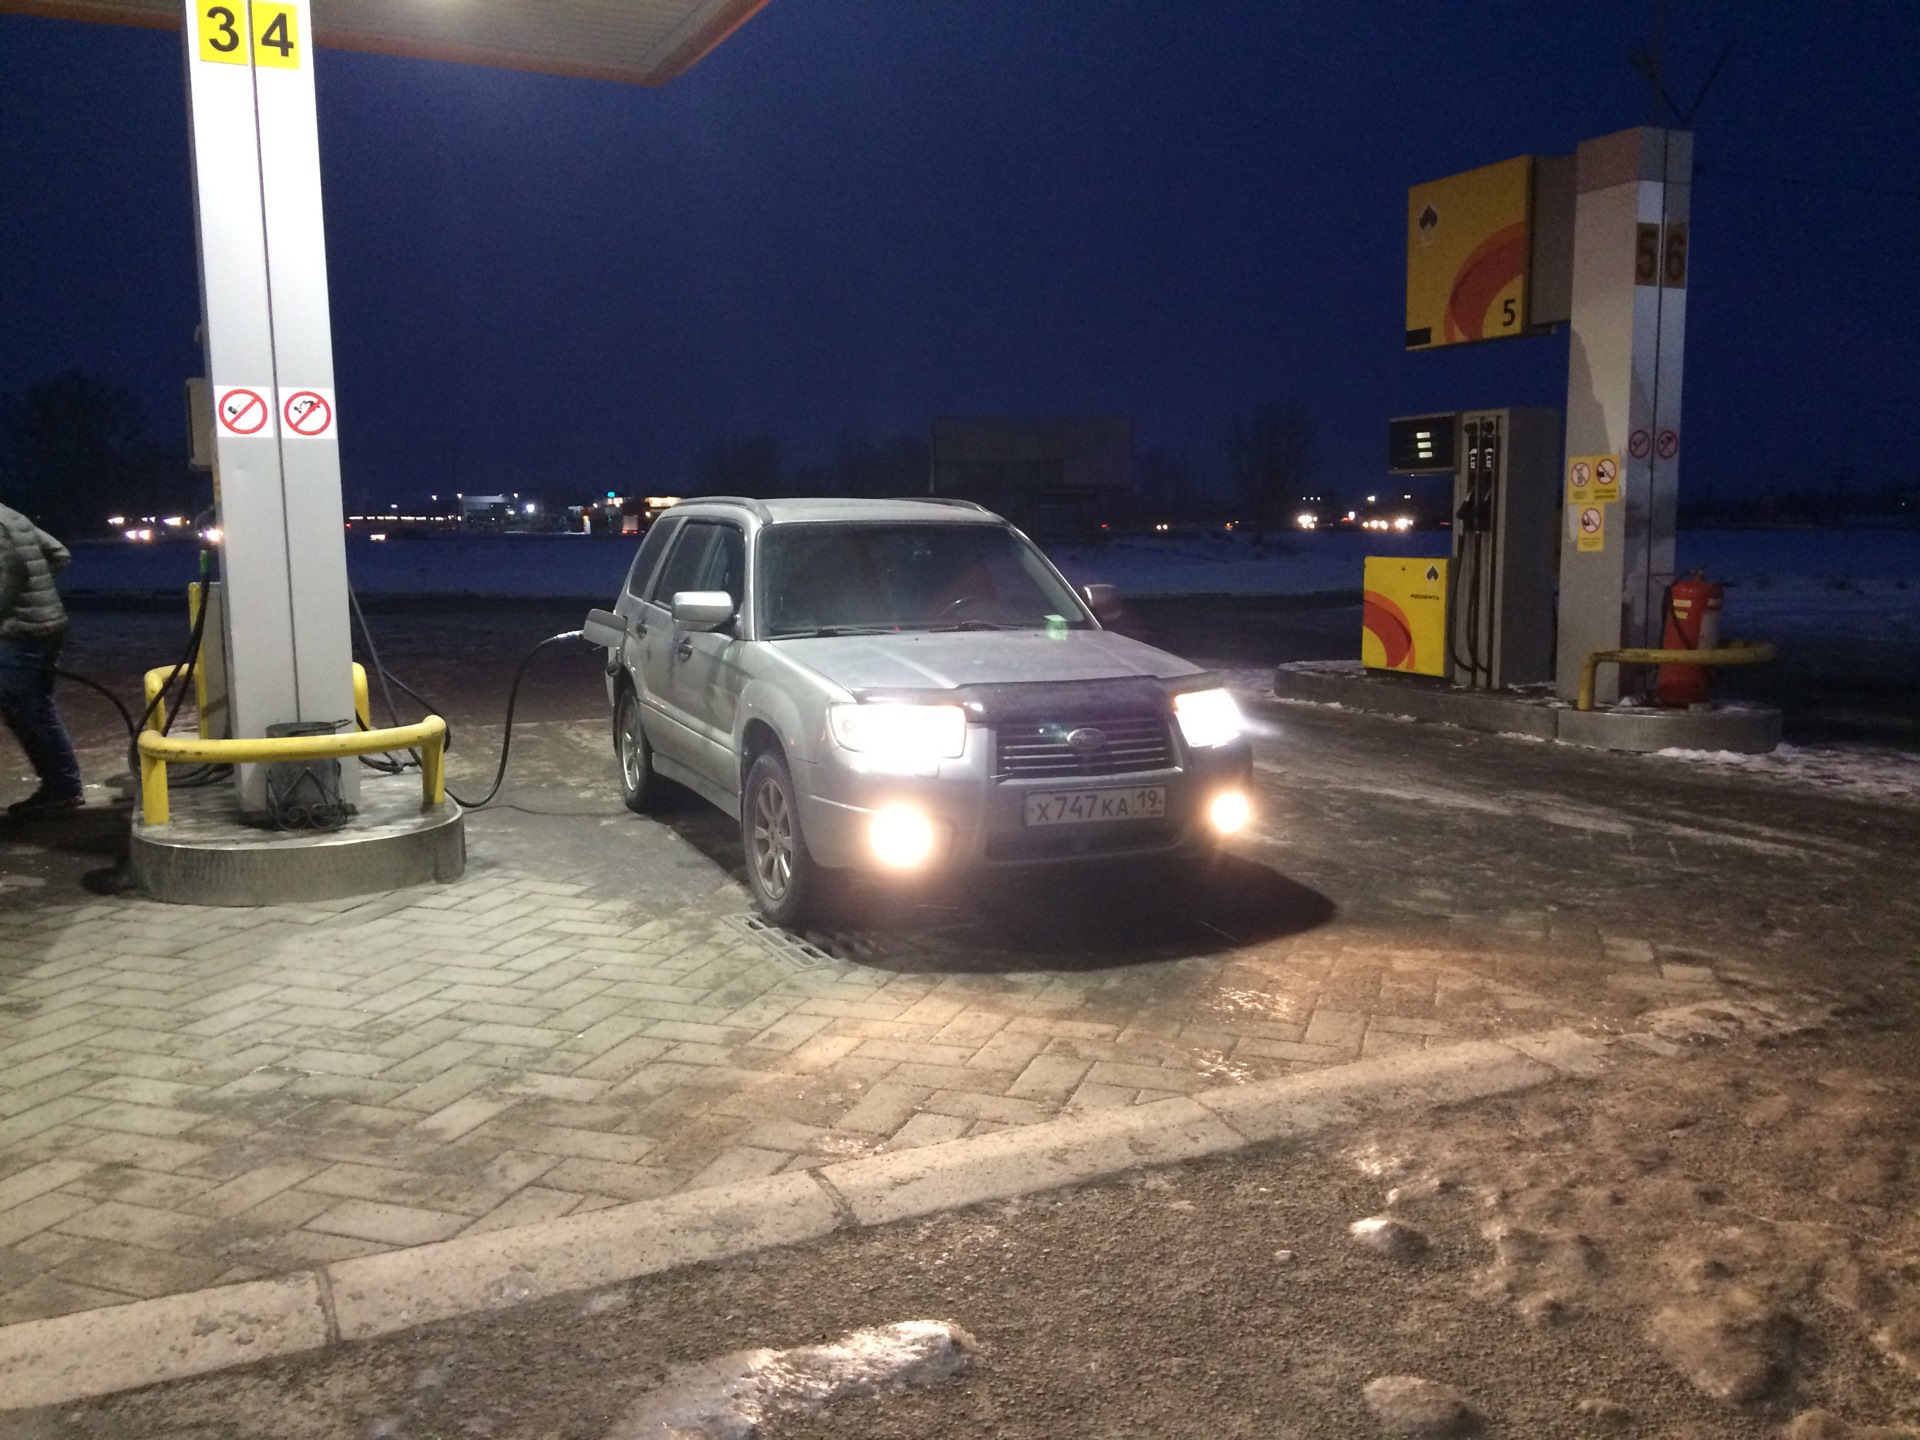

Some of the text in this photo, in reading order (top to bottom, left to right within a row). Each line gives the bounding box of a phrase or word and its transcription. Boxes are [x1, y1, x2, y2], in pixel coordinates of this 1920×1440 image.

[207, 6, 294, 57] 3 4
[1637, 230, 1686, 283] 5 6
[1502, 298, 1516, 327] 5
[1137, 790, 1158, 809] 19
